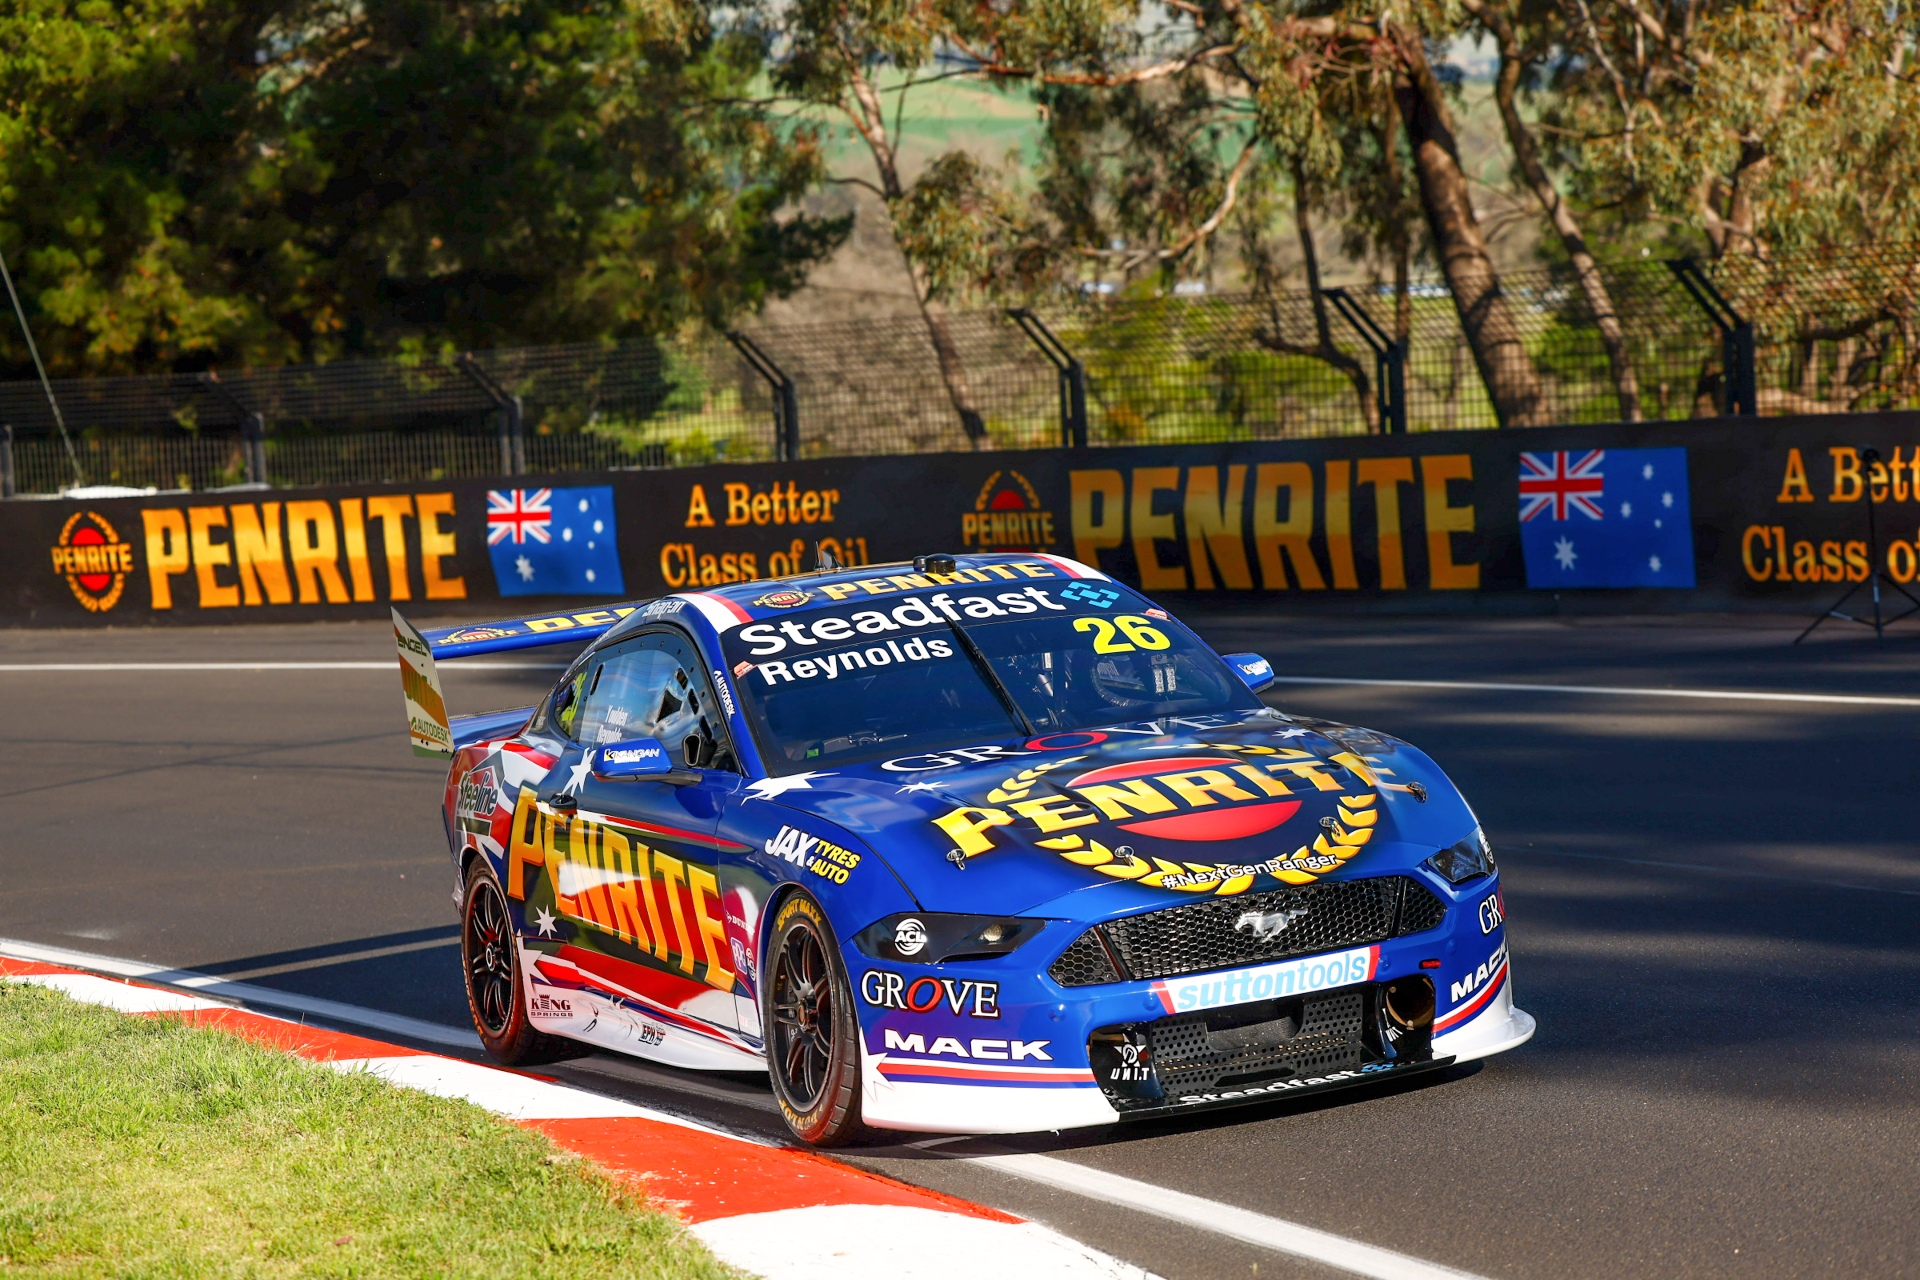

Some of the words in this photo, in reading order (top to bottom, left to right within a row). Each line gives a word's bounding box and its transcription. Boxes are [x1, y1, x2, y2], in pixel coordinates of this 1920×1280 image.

[1777, 448, 1814, 503] A
[685, 484, 715, 528] A
[723, 480, 840, 526] Better
[1069, 454, 1480, 591] PENRITE
[142, 492, 466, 610] PENRITE
[962, 512, 1056, 546] PENRITE
[52, 543, 133, 575] PENRITE
[660, 542, 759, 587] Class
[769, 538, 806, 578] of
[1742, 524, 1871, 583] Class
[753, 592, 815, 606] PENRITE
[816, 563, 1056, 601] PENRITE
[739, 586, 1067, 656] Steadfast
[1072, 615, 1171, 654] 26
[757, 637, 953, 687] Reynolds
[717, 677, 736, 720] AUTODESK
[417, 718, 449, 744] AUTODESK
[881, 714, 1245, 772] GROVE
[458, 771, 499, 816] Steeline
[931, 750, 1411, 859] PENRITE
[764, 825, 820, 868] JAX
[815, 840, 860, 869] TYRES
[806, 856, 815, 867] &
[508, 785, 737, 993] PENRITE
[810, 859, 849, 885] AUTO
[1161, 854, 1339, 890] #NextGenRanger
[894, 931, 924, 943] ACL
[862, 971, 998, 1017] GROVE
[1178, 953, 1367, 1009] suttontools
[884, 1028, 1053, 1060] MACK
[1179, 1070, 1365, 1105] Steadfast
